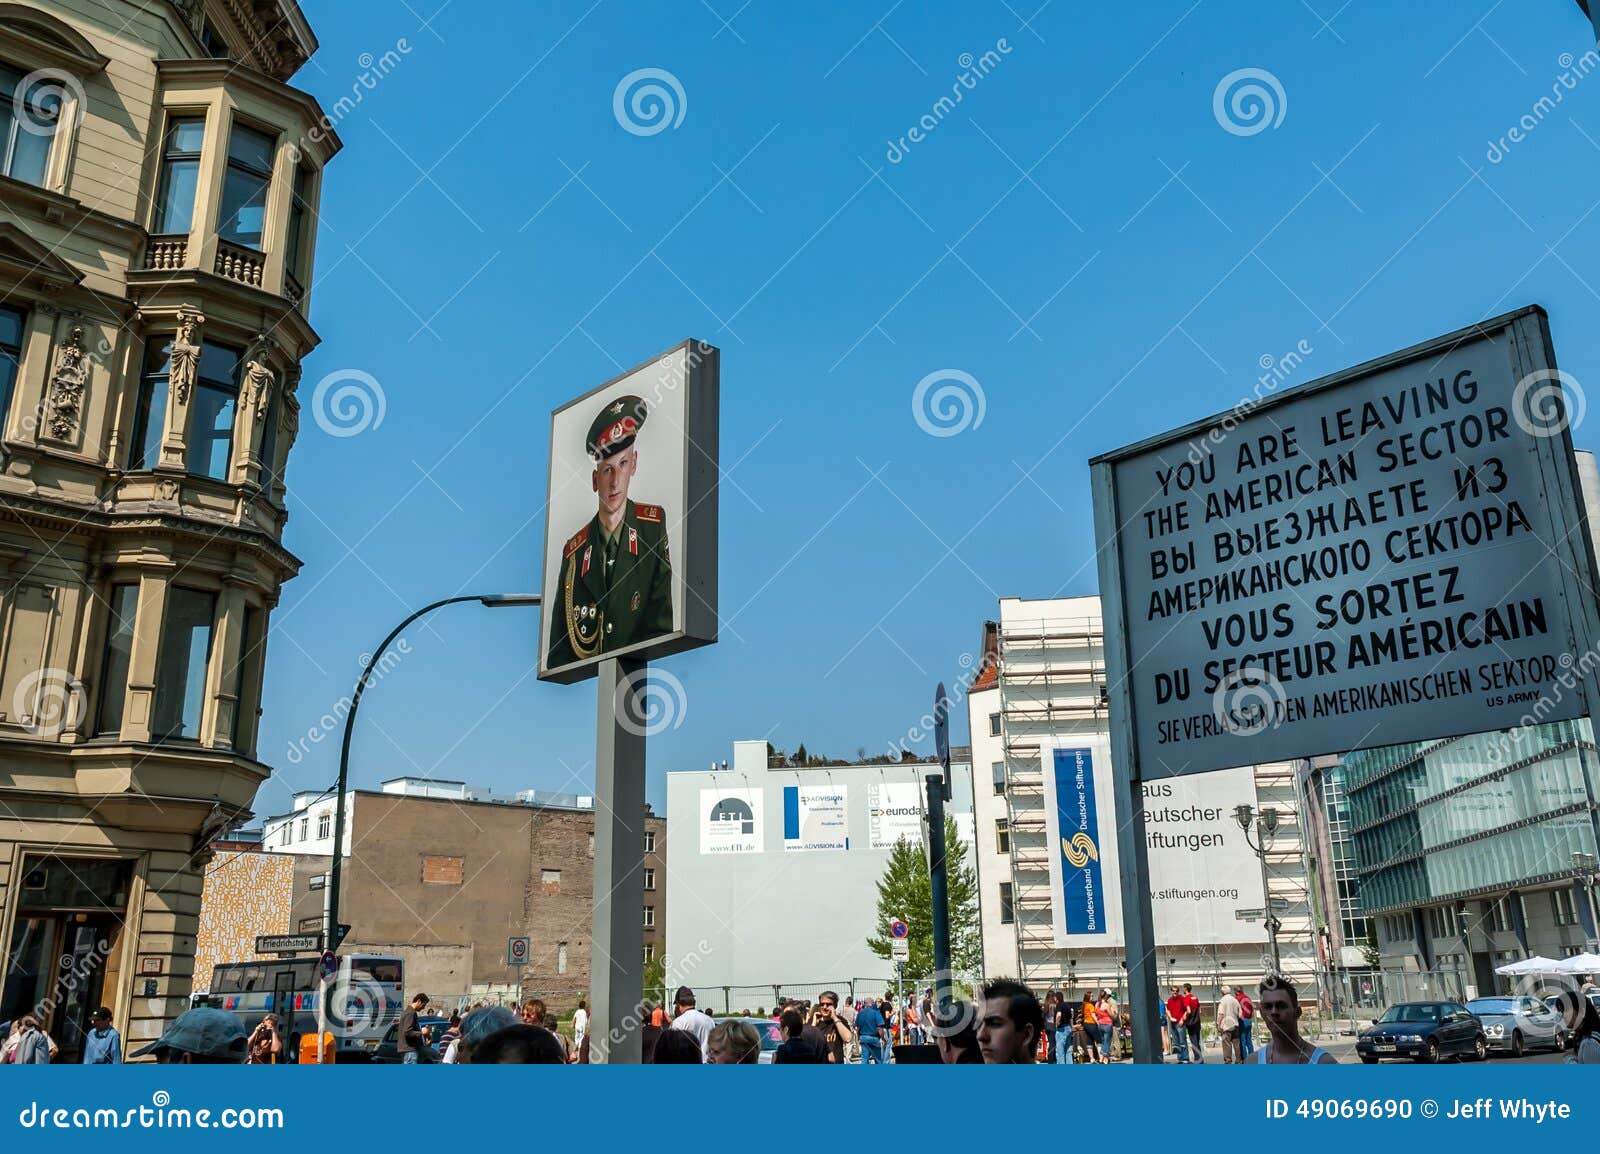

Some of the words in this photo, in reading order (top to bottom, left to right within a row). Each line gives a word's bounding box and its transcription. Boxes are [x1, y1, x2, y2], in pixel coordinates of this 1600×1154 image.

[1156, 458, 1215, 496] YOU
[1236, 427, 1299, 473] ARE
[1321, 370, 1478, 446] LEAVING
[1144, 501, 1190, 539] THE
[1205, 456, 1357, 523] AMERICAN
[1378, 406, 1509, 472] SECTOR
[1150, 541, 1195, 580] ВЫ
[1215, 479, 1429, 563] ВЫЕЗЖАЕТЕ
[1453, 458, 1508, 500] ИЗ
[1147, 538, 1370, 621] АМЕРИКАНСКОГО
[1384, 500, 1532, 563] СЕКТОРА
[1202, 603, 1293, 650] VOUS
[1315, 567, 1464, 629] SORTEZ
[1155, 669, 1190, 704] DU
[1203, 640, 1336, 695] SECTEUR
[1347, 598, 1547, 668] AMÉRICAIN
[1158, 721, 1180, 744] SIE
[1274, 697, 1307, 724] DEN
[1312, 668, 1472, 718] AMERIKANISCHEN
[1478, 655, 1557, 691] SEKTOR
[1487, 697, 1504, 707] US
[1507, 690, 1540, 705] ARMY
[1075, 751, 1084, 789] Stiftungen
[1142, 784, 1172, 797] aus
[1079, 791, 1087, 831] Deutscher
[1144, 805, 1222, 823] eutscher
[1147, 832, 1224, 852] iftungen
[1085, 868, 1096, 931] Bundesverband
[1151, 888, 1238, 901] .stiftungen.org
[263, 937, 313, 948] Friedrichstraße
